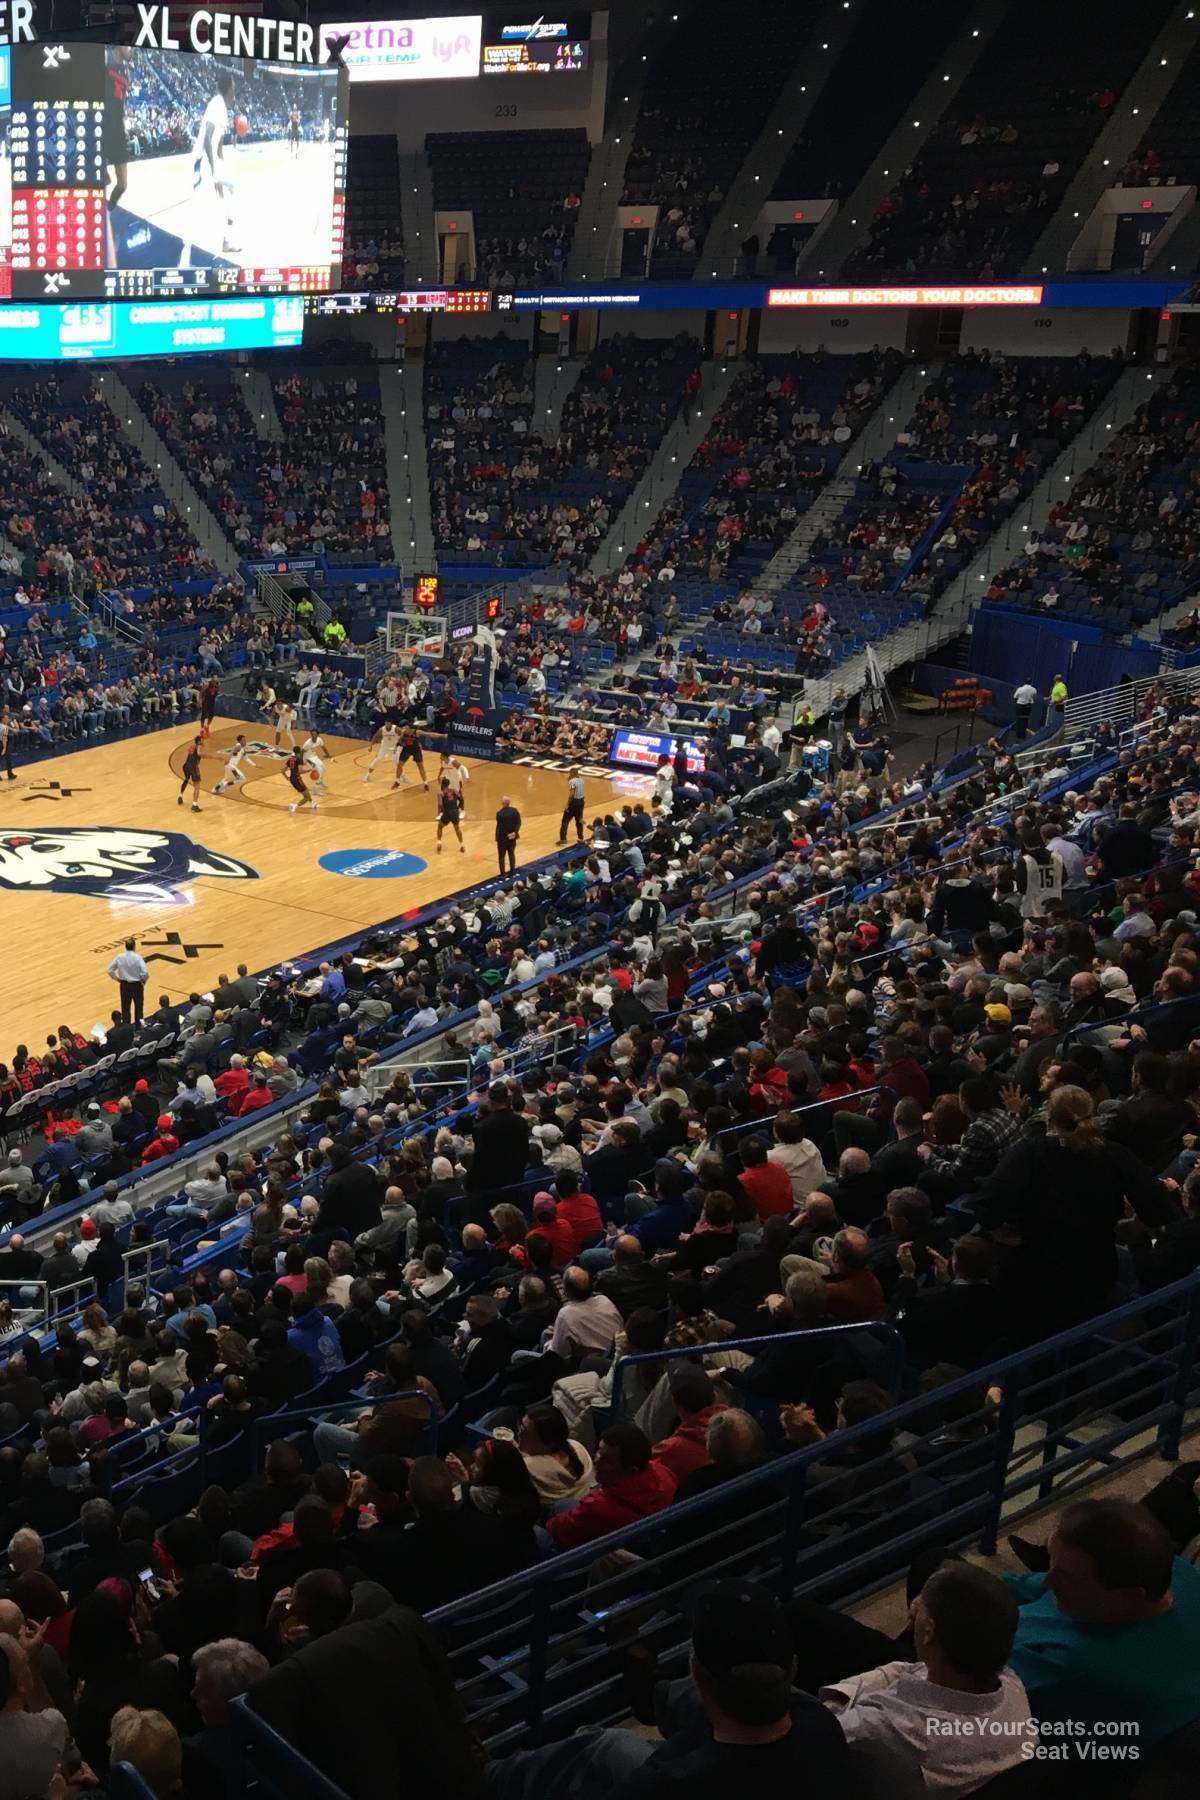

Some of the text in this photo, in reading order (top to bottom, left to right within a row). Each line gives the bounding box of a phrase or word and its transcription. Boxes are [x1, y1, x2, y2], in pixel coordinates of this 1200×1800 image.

[135, 4, 313, 63] XL CENTER
[43, 45, 70, 67] XL
[377, 53, 421, 64] TEMP
[488, 48, 520, 58] WATCH
[495, 105, 517, 117] 233
[44, 272, 70, 293] XL
[350, 296, 361, 306] 12
[376, 296, 397, 305] 11:22
[407, 295, 417, 305] 13
[770, 289, 1038, 303] MAKE THEIR DOCTORS YOUR DOCTORS.
[419, 587, 435, 602] 25
[452, 625, 473, 639] UCONN
[454, 722, 493, 736] TRAVELERS
[618, 750, 658, 764] NATIONA
[1039, 868, 1054, 889] 15
[89, 925, 166, 955] XL CNTER
